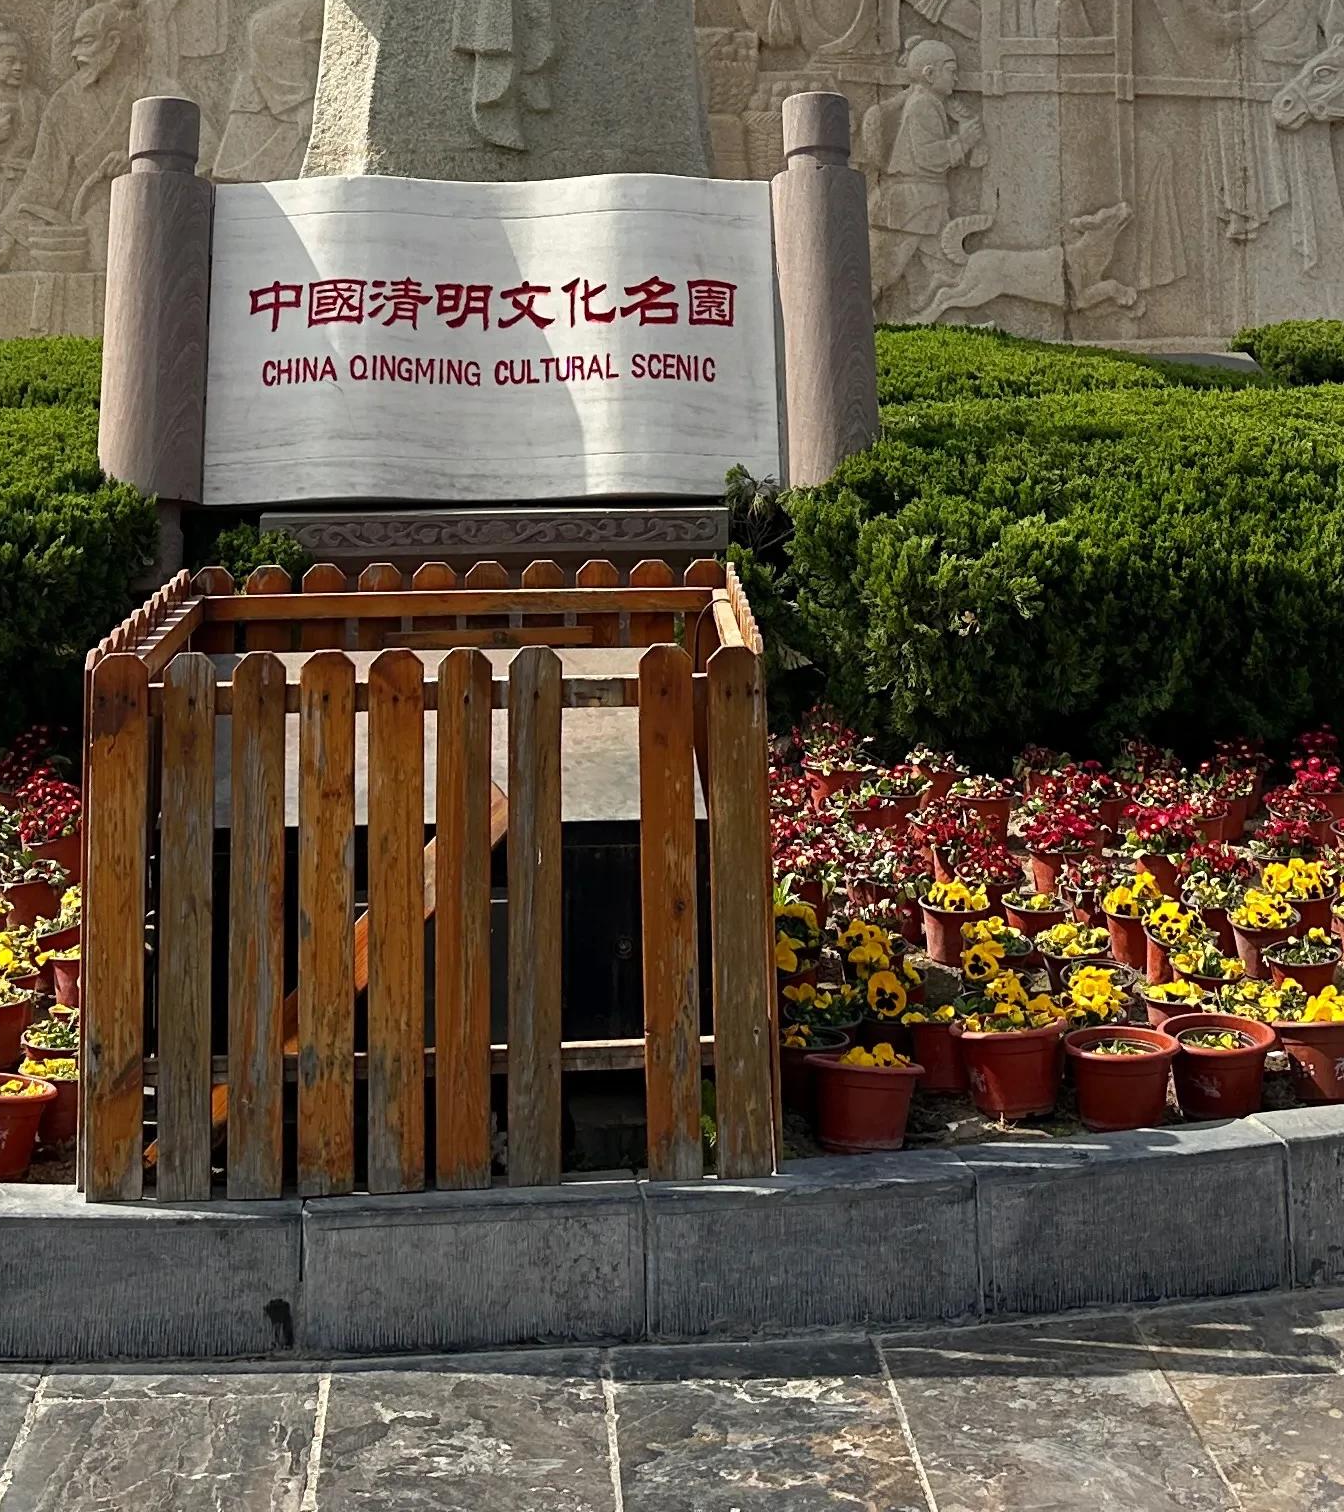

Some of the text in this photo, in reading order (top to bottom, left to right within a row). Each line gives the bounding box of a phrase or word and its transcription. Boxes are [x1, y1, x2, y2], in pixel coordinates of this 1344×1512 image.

[250, 277, 737, 331] 中國清明文化名園
[262, 353, 716, 386] CHINA QINGMING CULTURAL SCENIC
